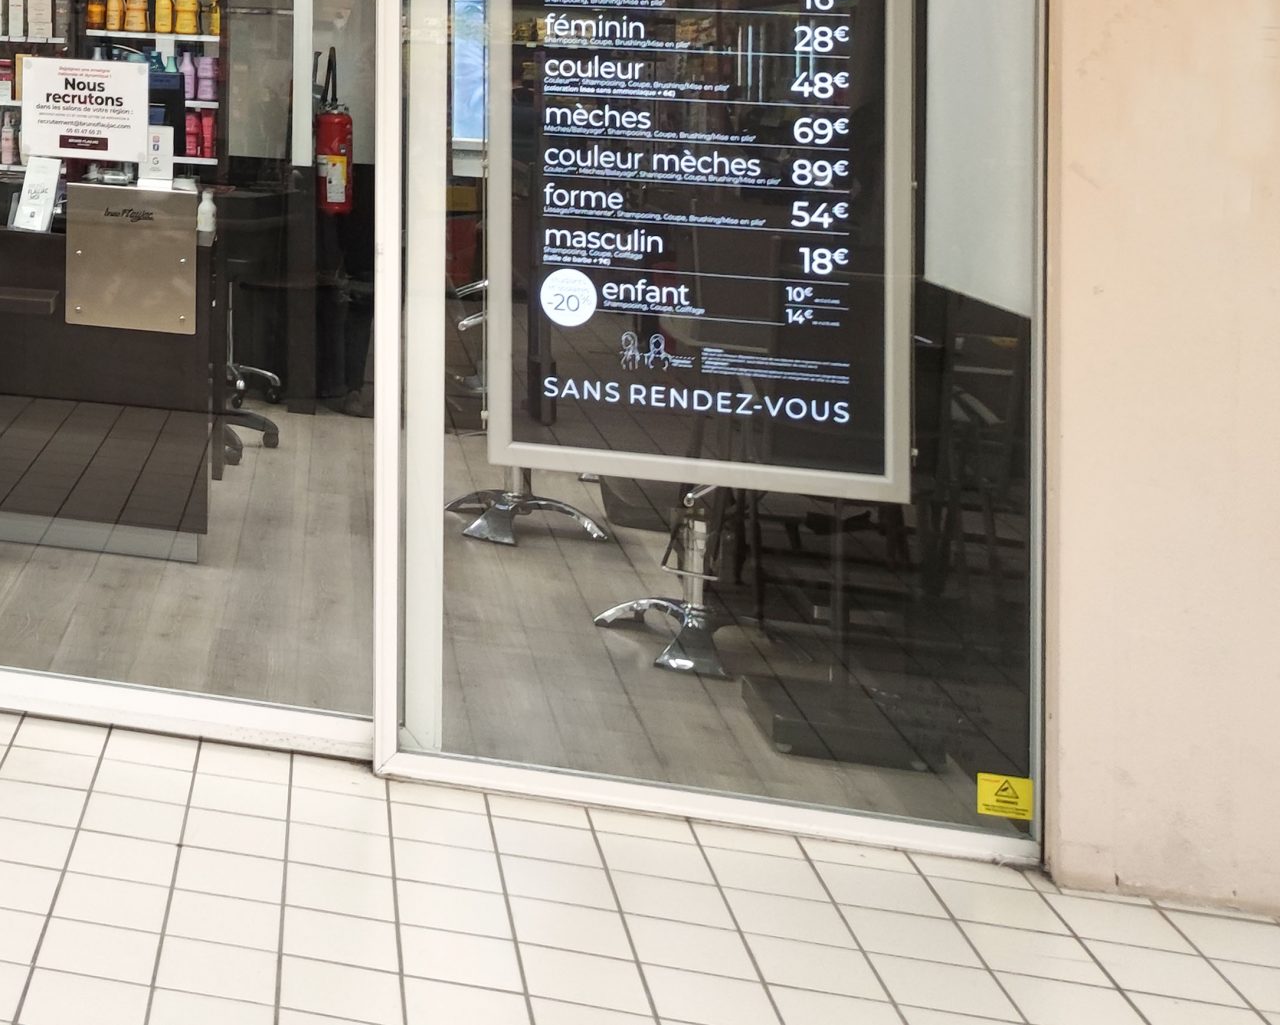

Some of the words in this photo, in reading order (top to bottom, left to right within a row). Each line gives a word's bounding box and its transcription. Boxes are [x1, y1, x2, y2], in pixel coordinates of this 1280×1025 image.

[544, 13, 645, 39] féminin
[794, 25, 849, 52] 28€
[65, 77, 105, 92] Nous
[545, 55, 644, 80] couleur
[791, 71, 849, 98] 48€
[46, 92, 124, 107] recrutons
[545, 103, 651, 129] mèches
[794, 117, 849, 145] 69€
[544, 145, 644, 170] couleur
[653, 149, 761, 176] mèches
[791, 159, 849, 187] 89€
[544, 182, 624, 209] forme
[791, 201, 849, 228] 54€
[545, 228, 663, 253] masculin
[799, 247, 849, 275] 18€
[602, 279, 690, 305] enfant
[785, 286, 813, 302] 10€
[785, 308, 813, 324] 14€
[543, 377, 620, 403] SANS
[629, 384, 850, 423] RENDEZ-VOUS
